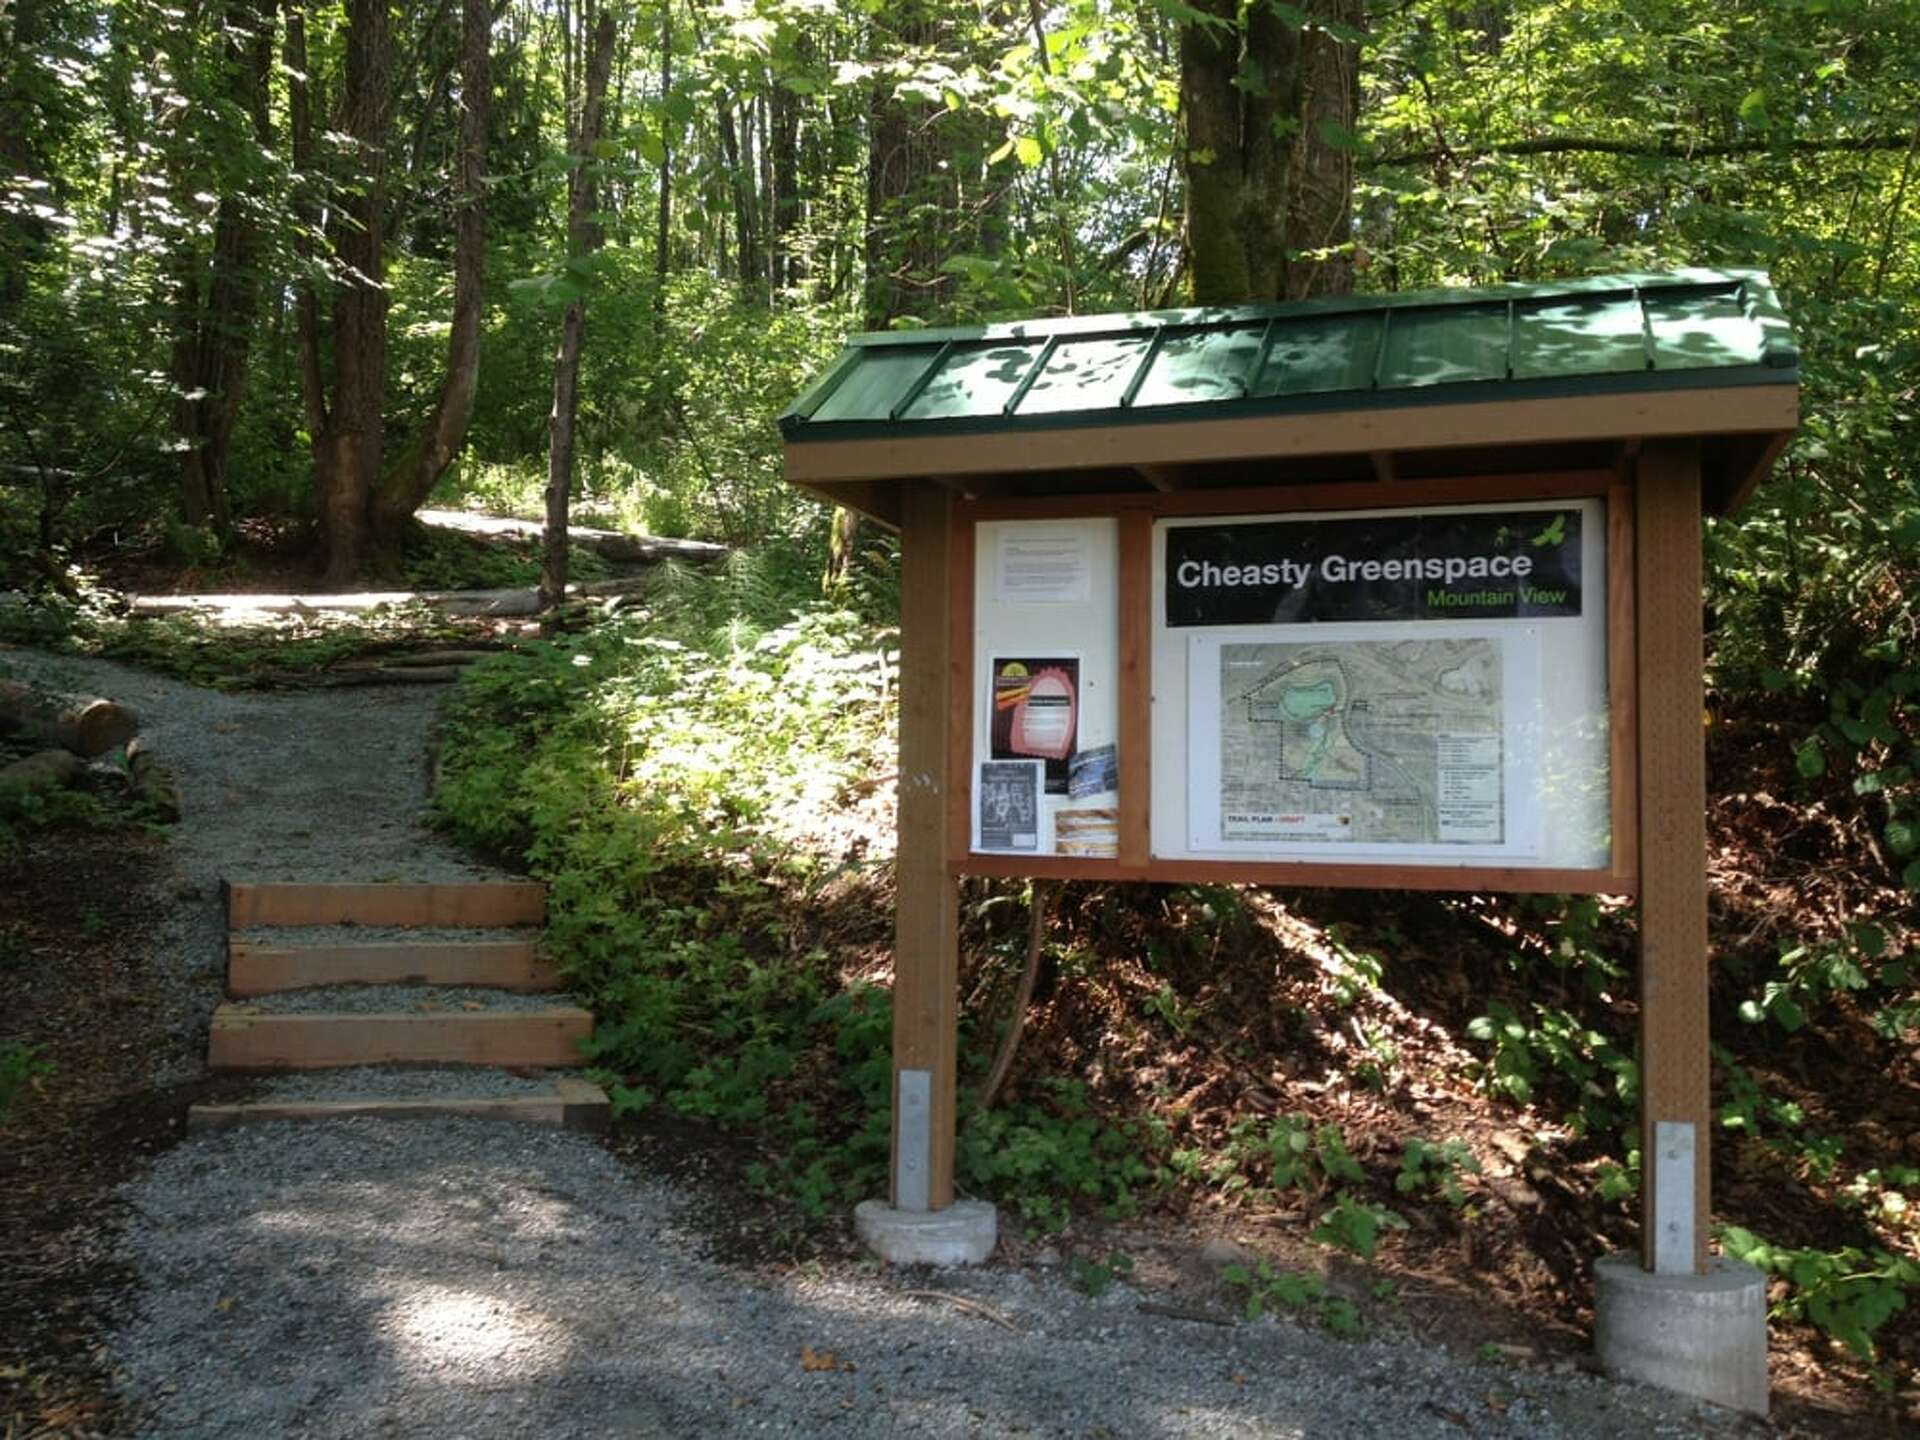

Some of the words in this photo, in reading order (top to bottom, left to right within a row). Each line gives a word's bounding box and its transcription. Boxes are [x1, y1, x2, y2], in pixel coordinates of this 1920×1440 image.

[1177, 558, 1311, 588] Cheasty
[1321, 553, 1532, 584] Greenspace
[1428, 588, 1514, 608] Mountain
[1519, 586, 1567, 606] View
